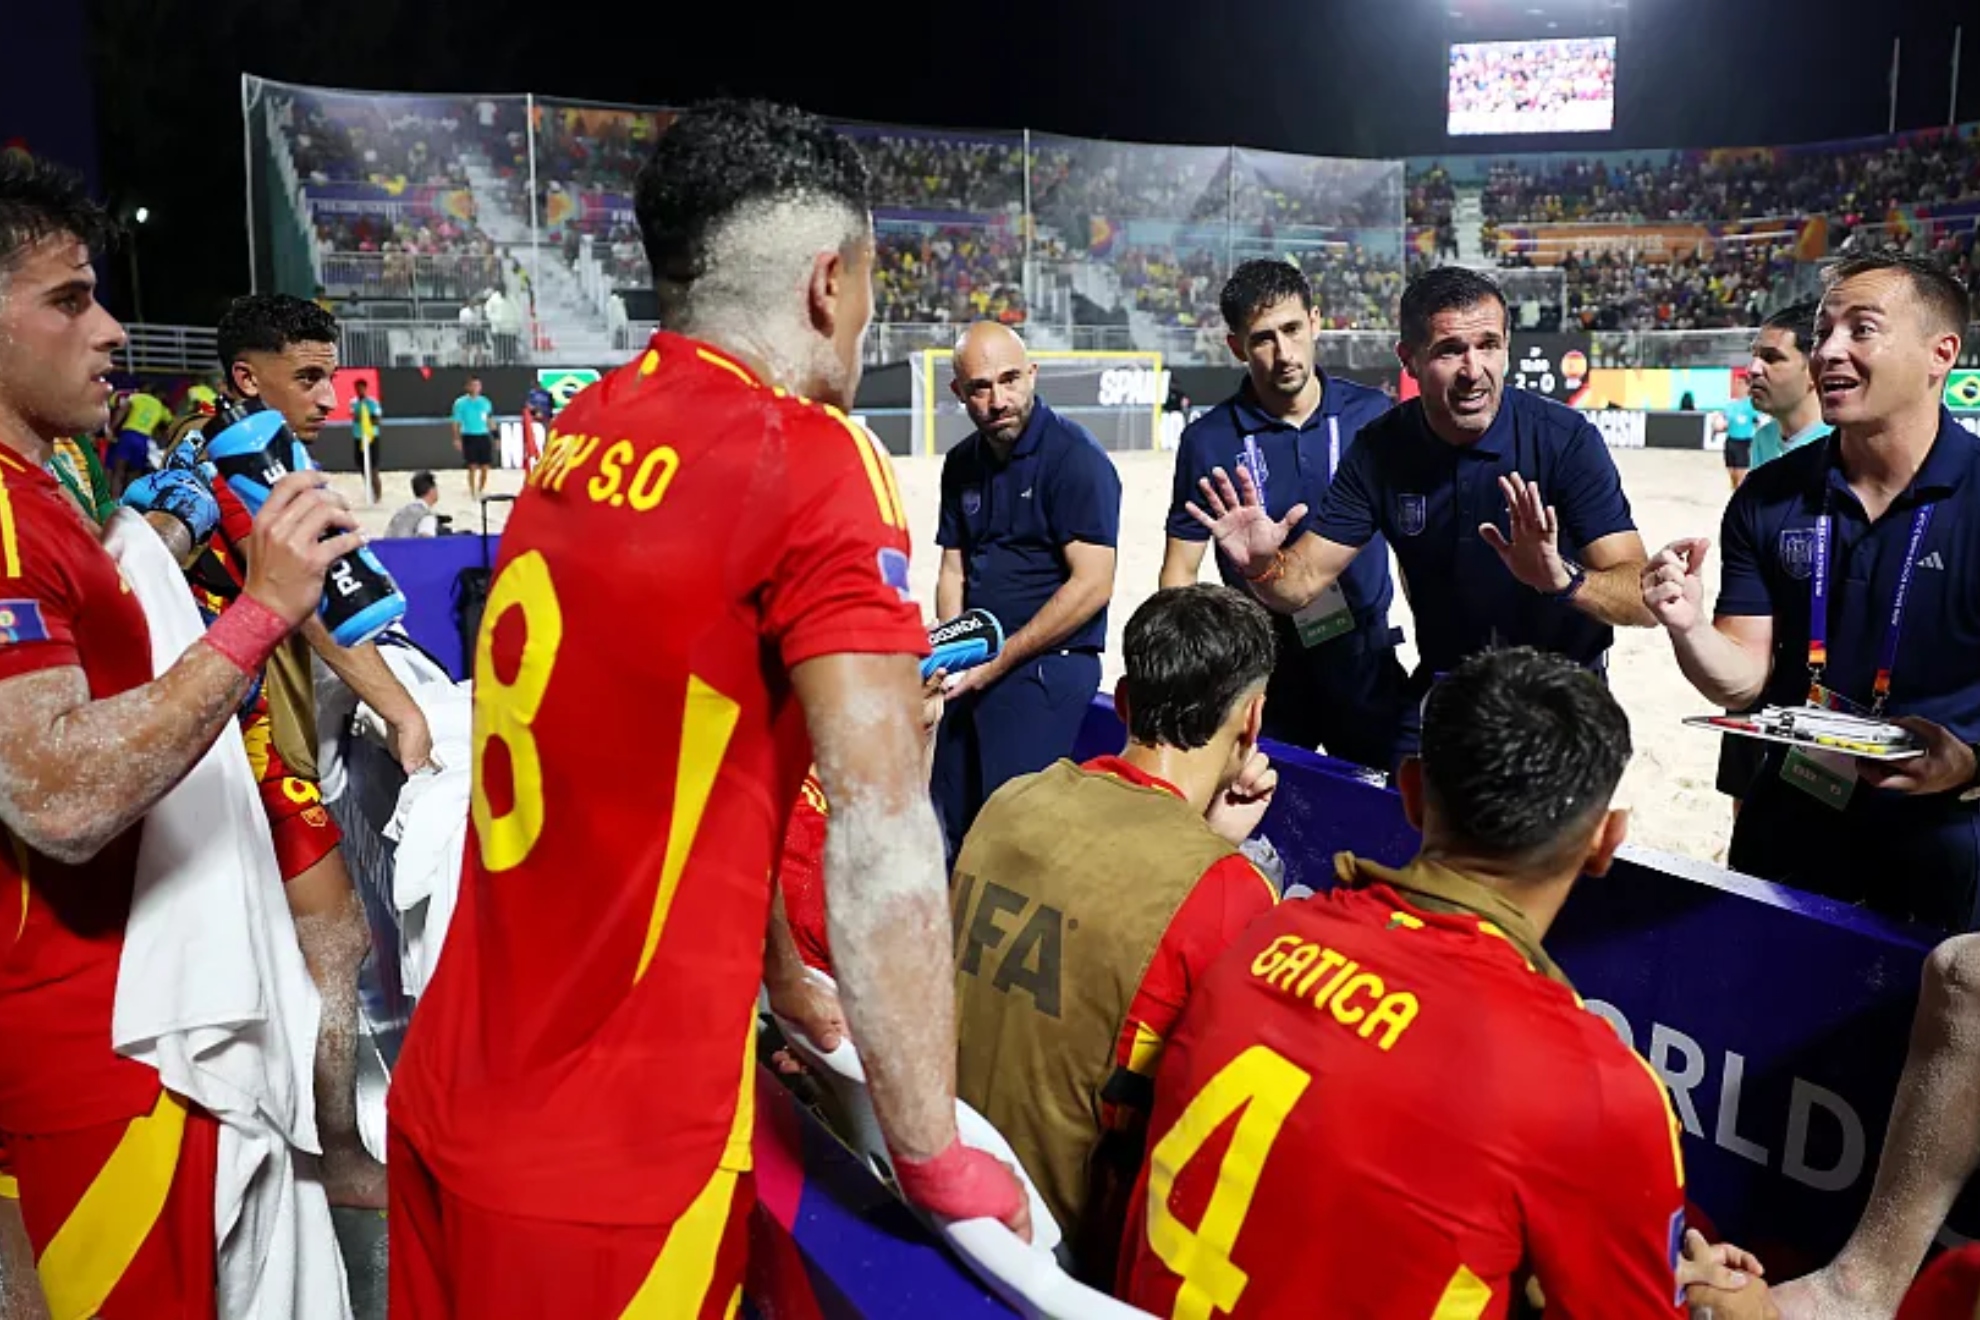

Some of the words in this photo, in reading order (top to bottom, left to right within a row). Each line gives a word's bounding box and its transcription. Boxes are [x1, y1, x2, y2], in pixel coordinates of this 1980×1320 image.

[1515, 373, 1527, 390] 2
[1540, 373, 1556, 394] 0
[471, 548, 563, 873] 8
[953, 870, 1064, 1021] IFA
[1250, 934, 1420, 1051] GATICA
[1145, 1043, 1312, 1320] 4
